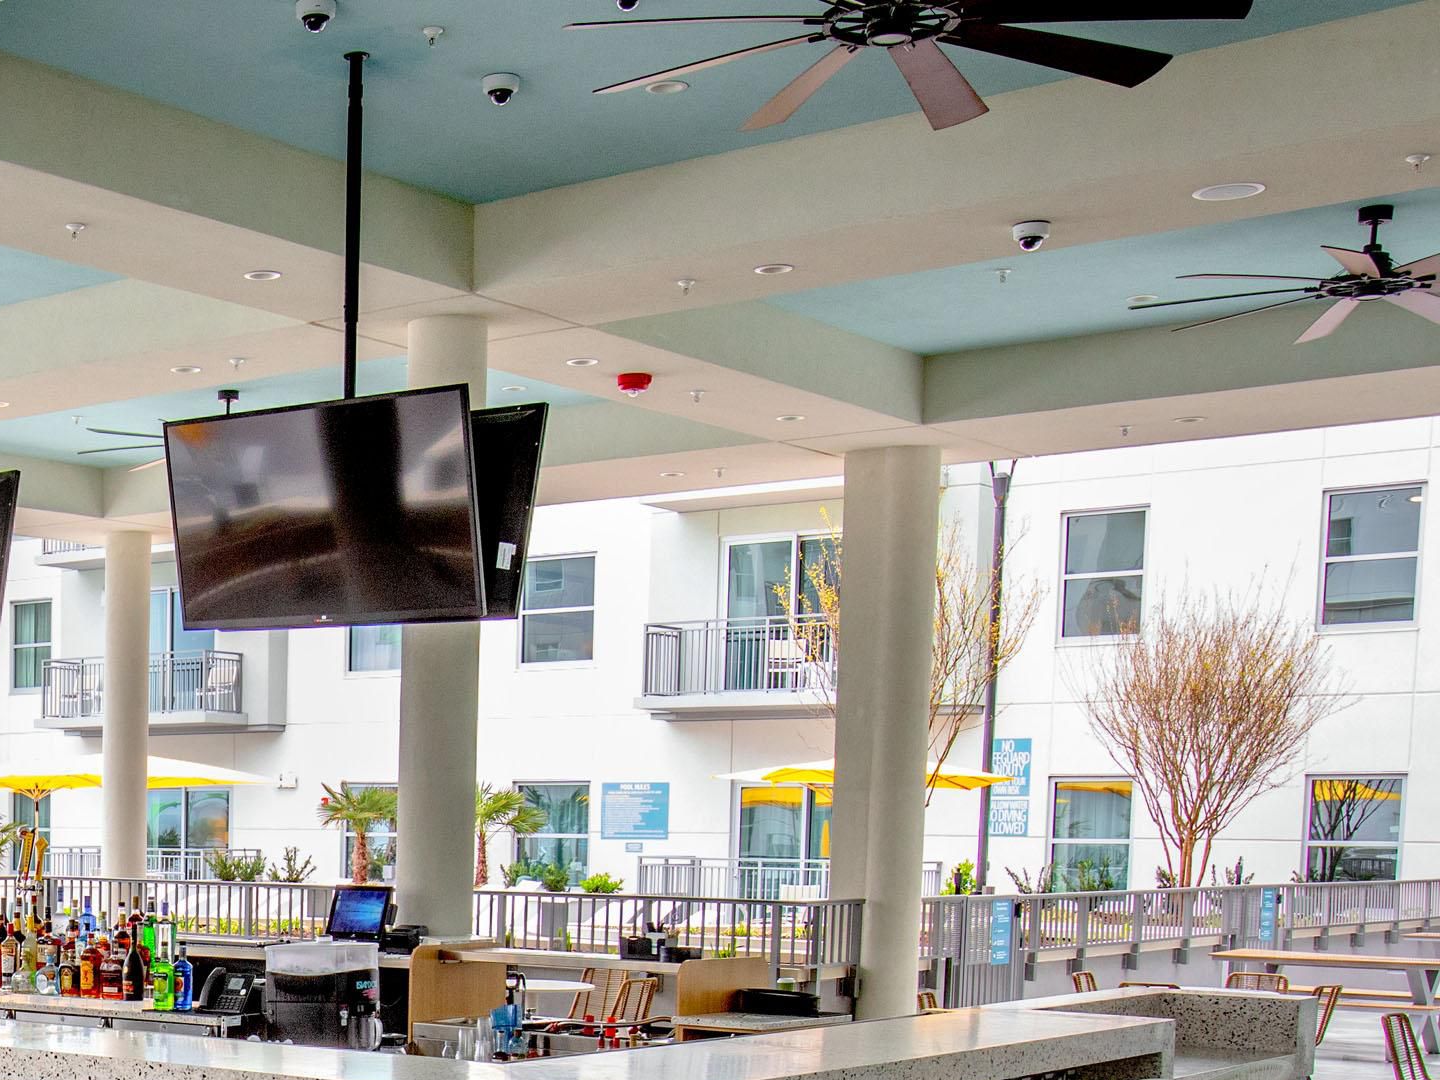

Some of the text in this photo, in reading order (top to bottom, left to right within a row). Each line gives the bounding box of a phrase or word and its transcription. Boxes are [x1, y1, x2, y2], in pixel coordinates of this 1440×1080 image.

[1001, 740, 1015, 752] NO
[992, 751, 1030, 765] FEGUARD
[1003, 763, 1025, 776] DUTY
[998, 809, 1026, 822] DIVING
